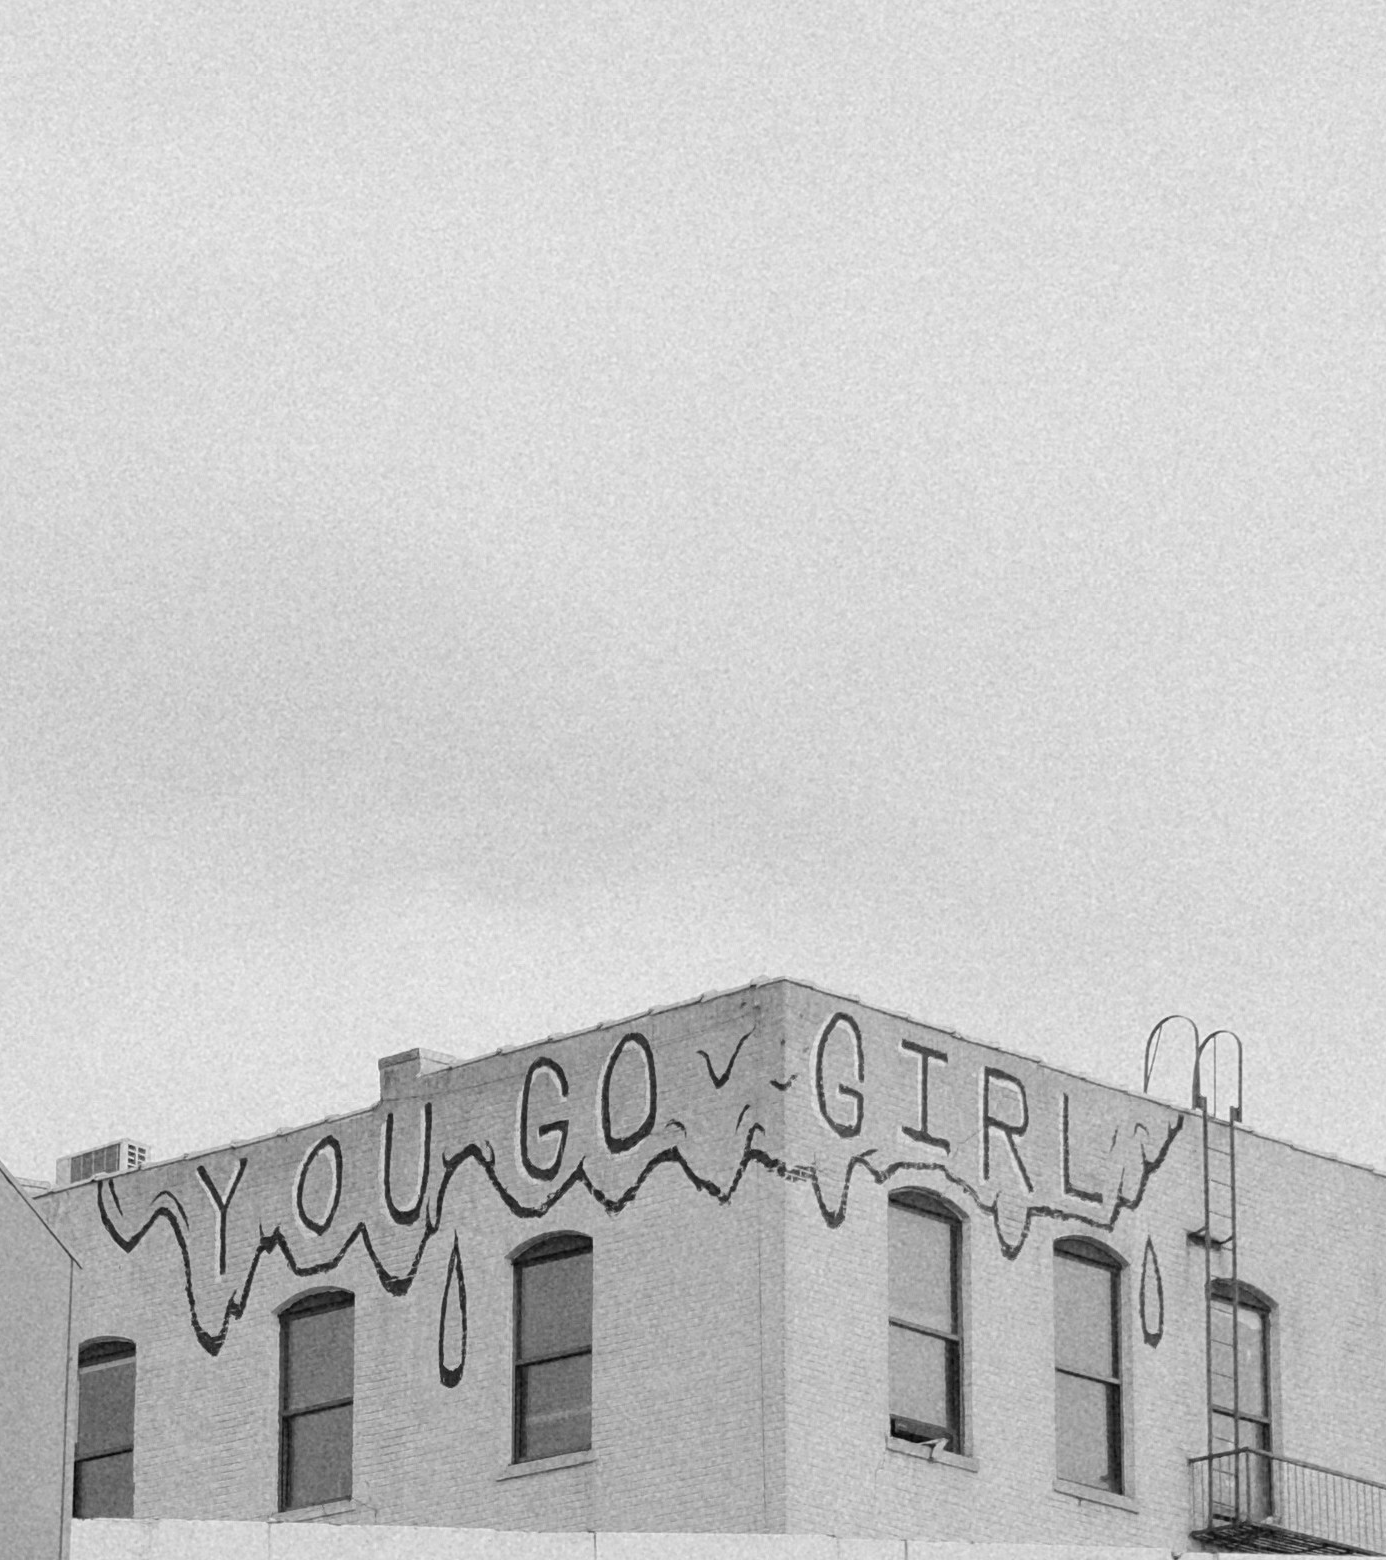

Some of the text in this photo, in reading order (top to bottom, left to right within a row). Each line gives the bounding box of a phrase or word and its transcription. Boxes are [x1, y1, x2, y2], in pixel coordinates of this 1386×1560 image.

[197, 1011, 1105, 1277] YOU GO GIRL
